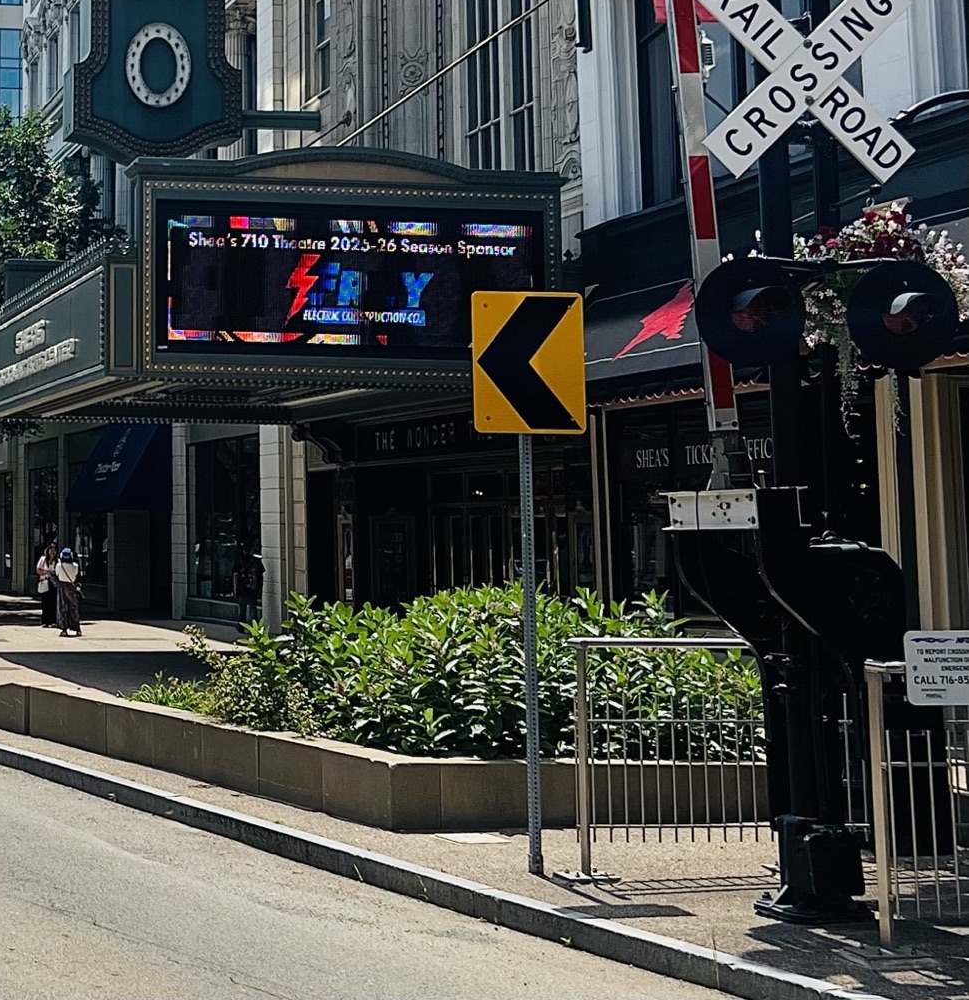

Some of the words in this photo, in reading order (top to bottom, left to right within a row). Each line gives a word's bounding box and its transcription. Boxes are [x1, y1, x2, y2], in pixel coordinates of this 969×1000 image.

[819, 85, 902, 169] ROAD
[189, 231, 237, 248] Shea's
[241, 233, 269, 249] 710
[272, 234, 326, 250] Theatre
[331, 236, 397, 253] 2025-26
[401, 239, 453, 255] Season
[457, 240, 516, 258] Sponsor
[375, 430, 395, 451] THE
[636, 448, 669, 468] SHEA'S
[684, 445, 713, 464] TICK
[747, 437, 773, 460] FFIC
[914, 675, 937, 685] CALL
